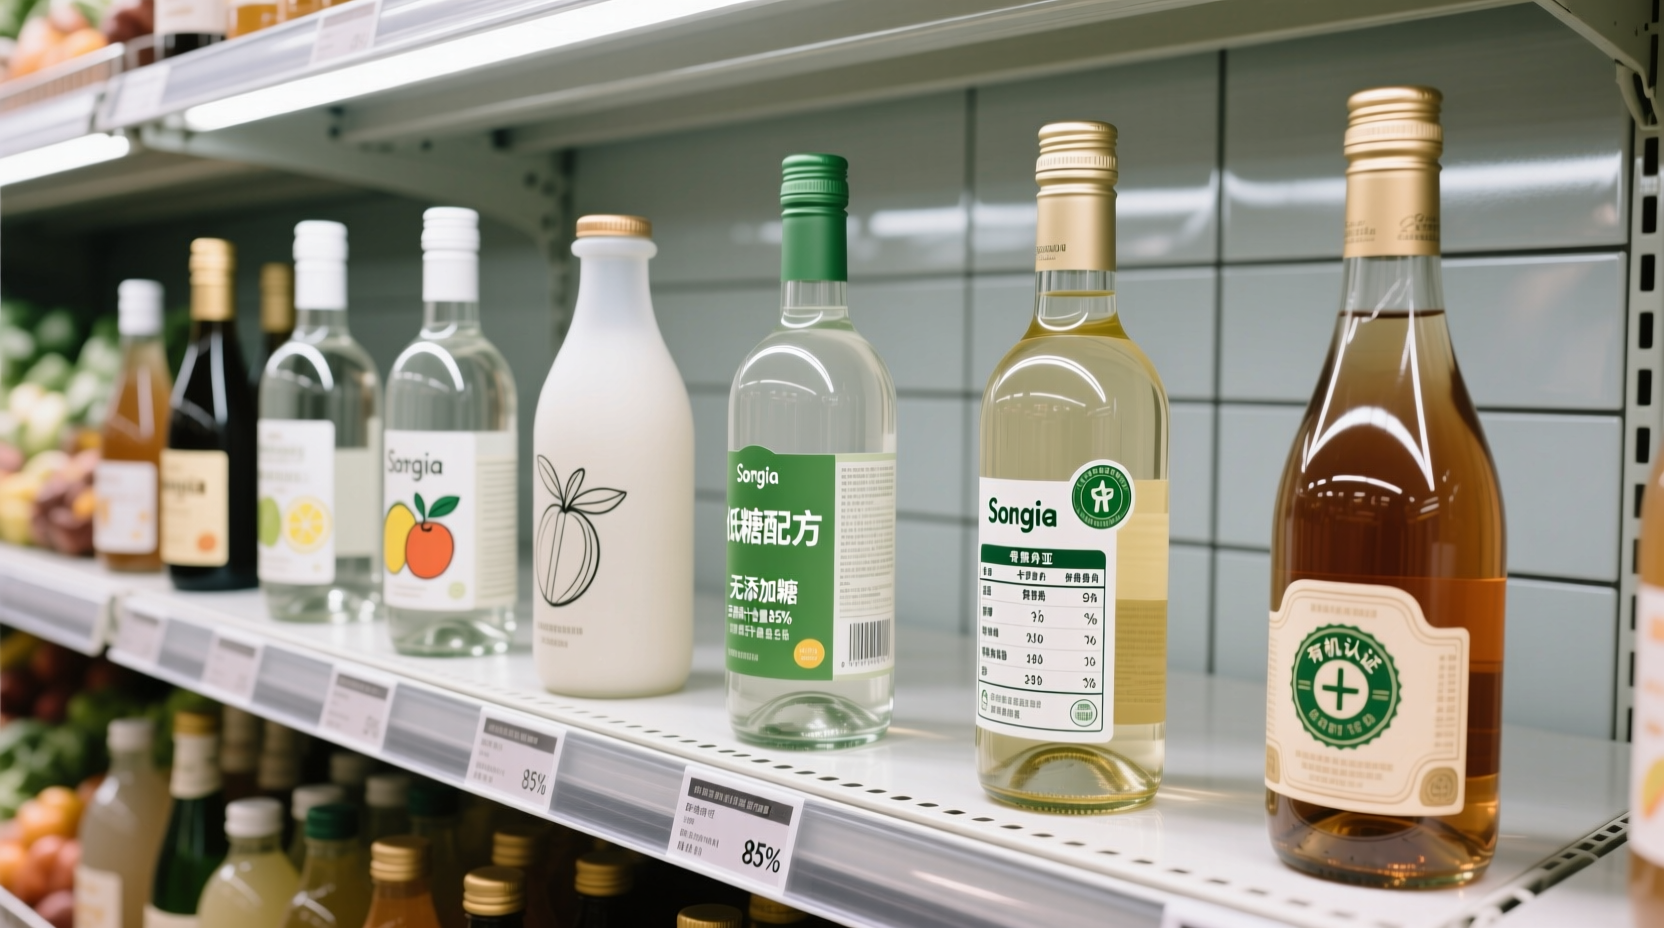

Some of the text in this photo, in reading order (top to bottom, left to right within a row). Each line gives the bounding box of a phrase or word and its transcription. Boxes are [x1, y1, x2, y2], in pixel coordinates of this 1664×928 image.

[726, 506, 823, 547] 低糖配方
[988, 496, 1057, 533] Songia
[729, 574, 799, 605] 无添加糖
[1306, 637, 1383, 675] 有机认证
[521, 768, 547, 795] 85%
[741, 839, 781, 873] 85%
